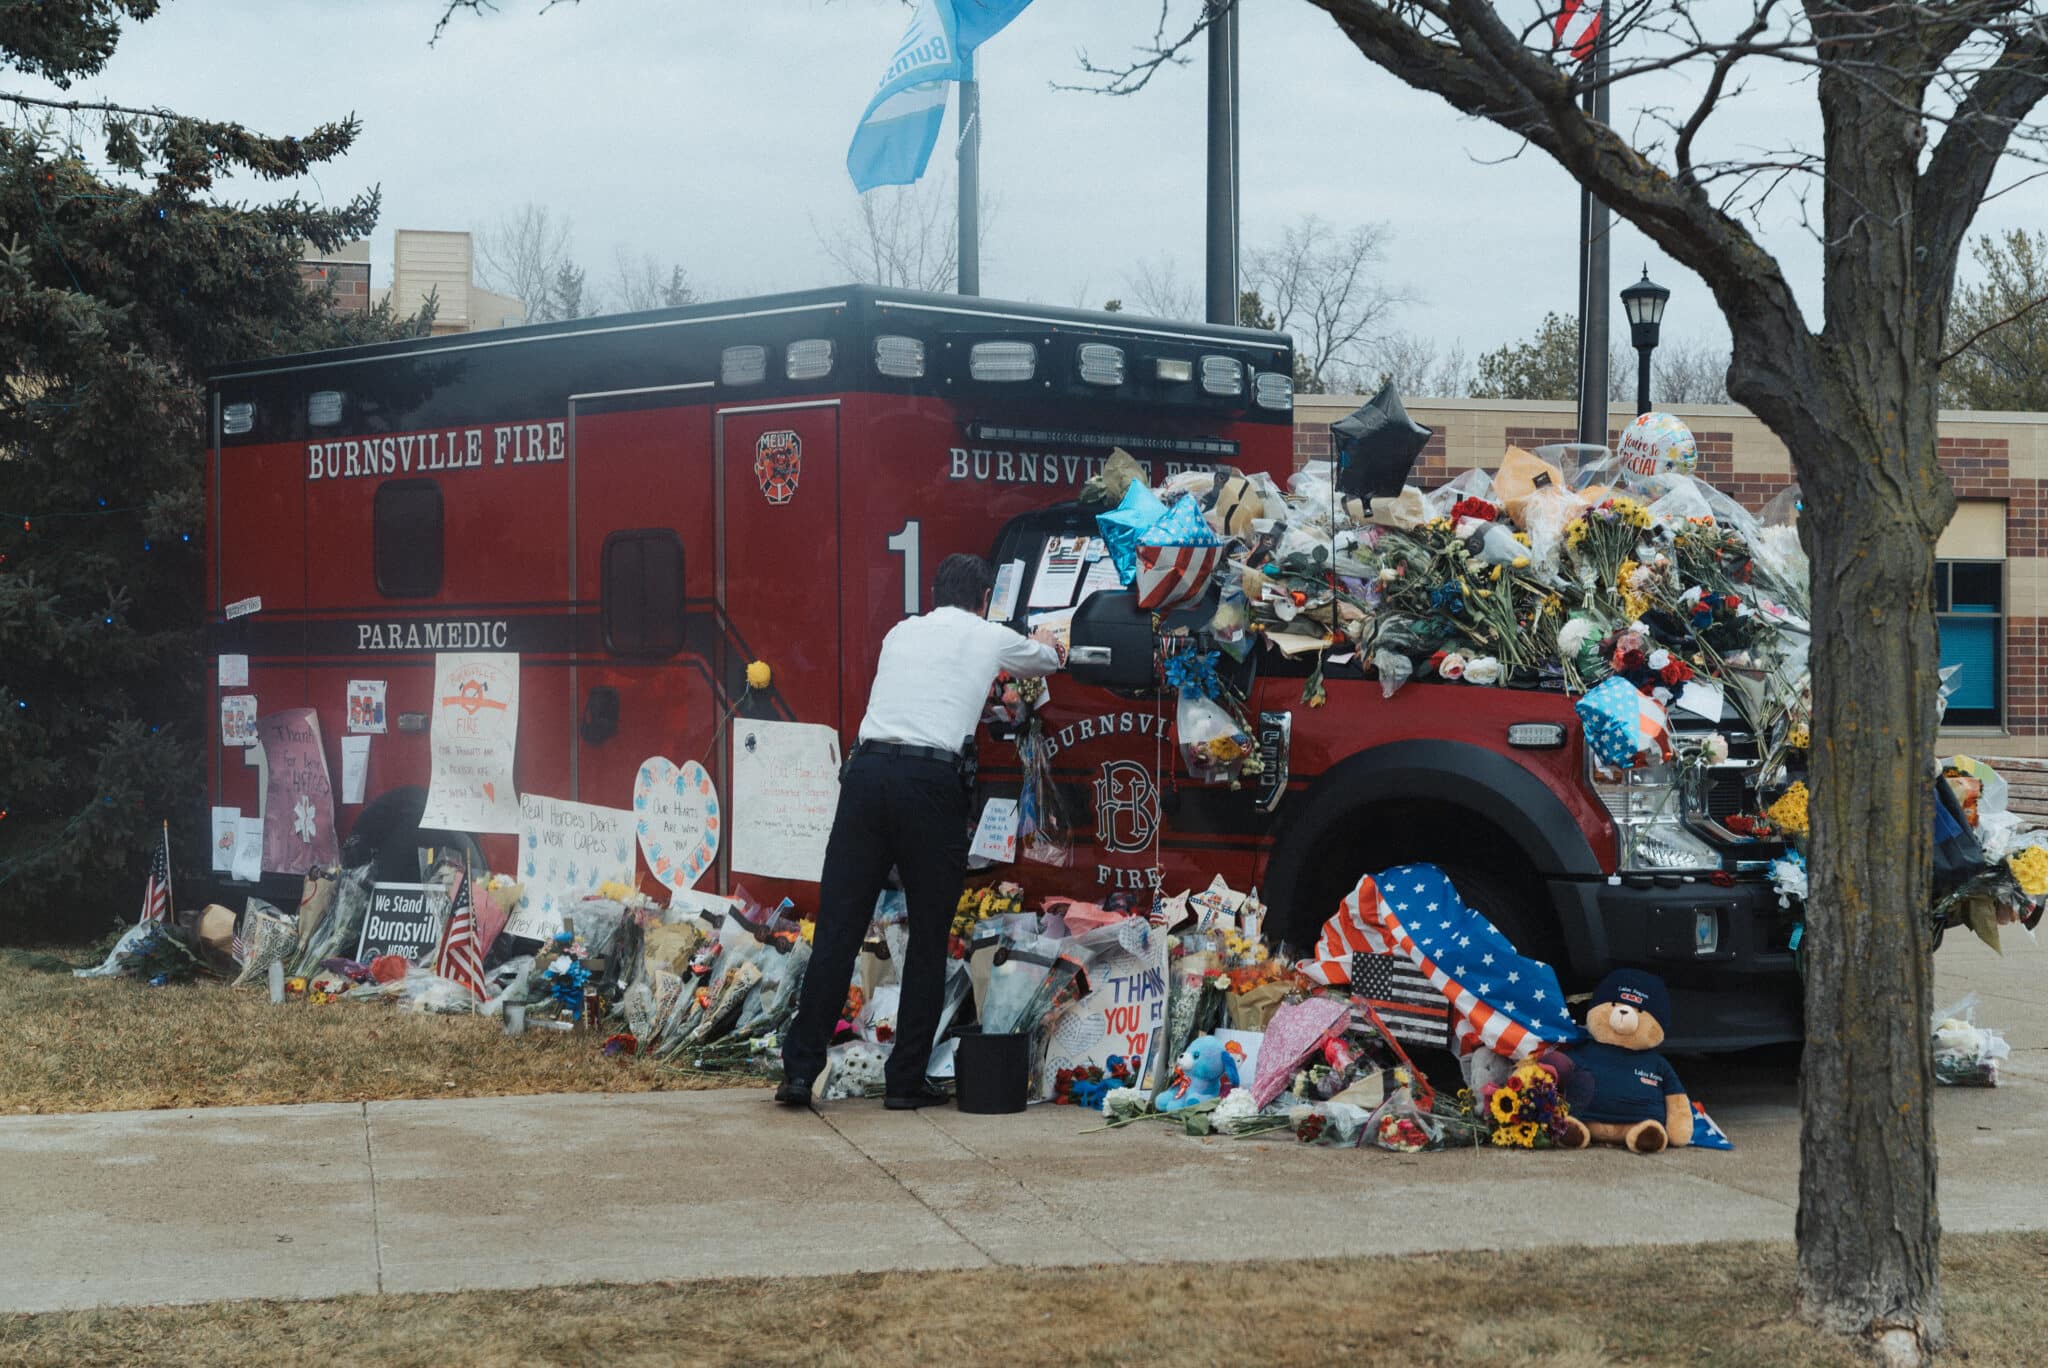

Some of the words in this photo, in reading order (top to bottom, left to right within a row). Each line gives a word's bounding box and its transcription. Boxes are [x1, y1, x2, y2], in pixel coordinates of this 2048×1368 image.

[308, 429, 482, 479] BURNSVILLE
[494, 422, 565, 464] FIRE
[950, 448, 1152, 488] BURNSVILE
[887, 520, 920, 615] 1
[358, 621, 508, 650] PARAMEDIC
[1044, 712, 1170, 760] BURNSVI
[521, 794, 544, 821] Real
[550, 804, 585, 829] Heroes
[590, 812, 617, 833] Don't
[573, 831, 607, 856] Capes
[1096, 864, 1160, 889] FIRE
[375, 894, 390, 911] We
[392, 895, 424, 913] Stand
[368, 915, 439, 944] Burnsvill
[386, 944, 420, 960] HEROES
[1108, 966, 1166, 1004] THANK
[1104, 1005, 1141, 1036] YOU
[1126, 1032, 1149, 1056] YO
